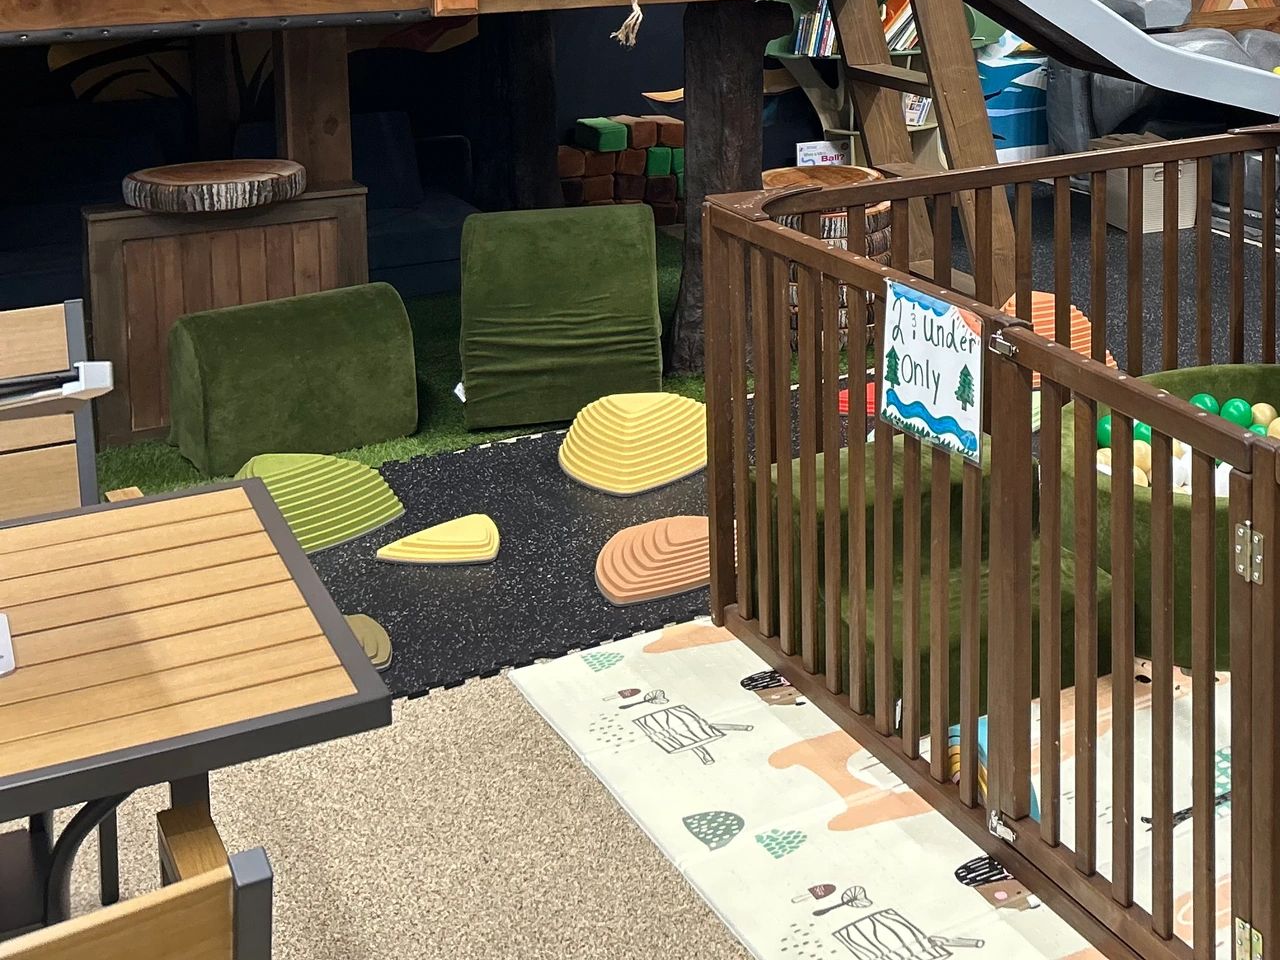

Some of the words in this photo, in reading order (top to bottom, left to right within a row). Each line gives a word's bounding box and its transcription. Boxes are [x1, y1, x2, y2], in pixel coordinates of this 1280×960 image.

[820, 153, 845, 162] Ball?
[891, 297, 905, 345] 2
[901, 354, 941, 405] Only
